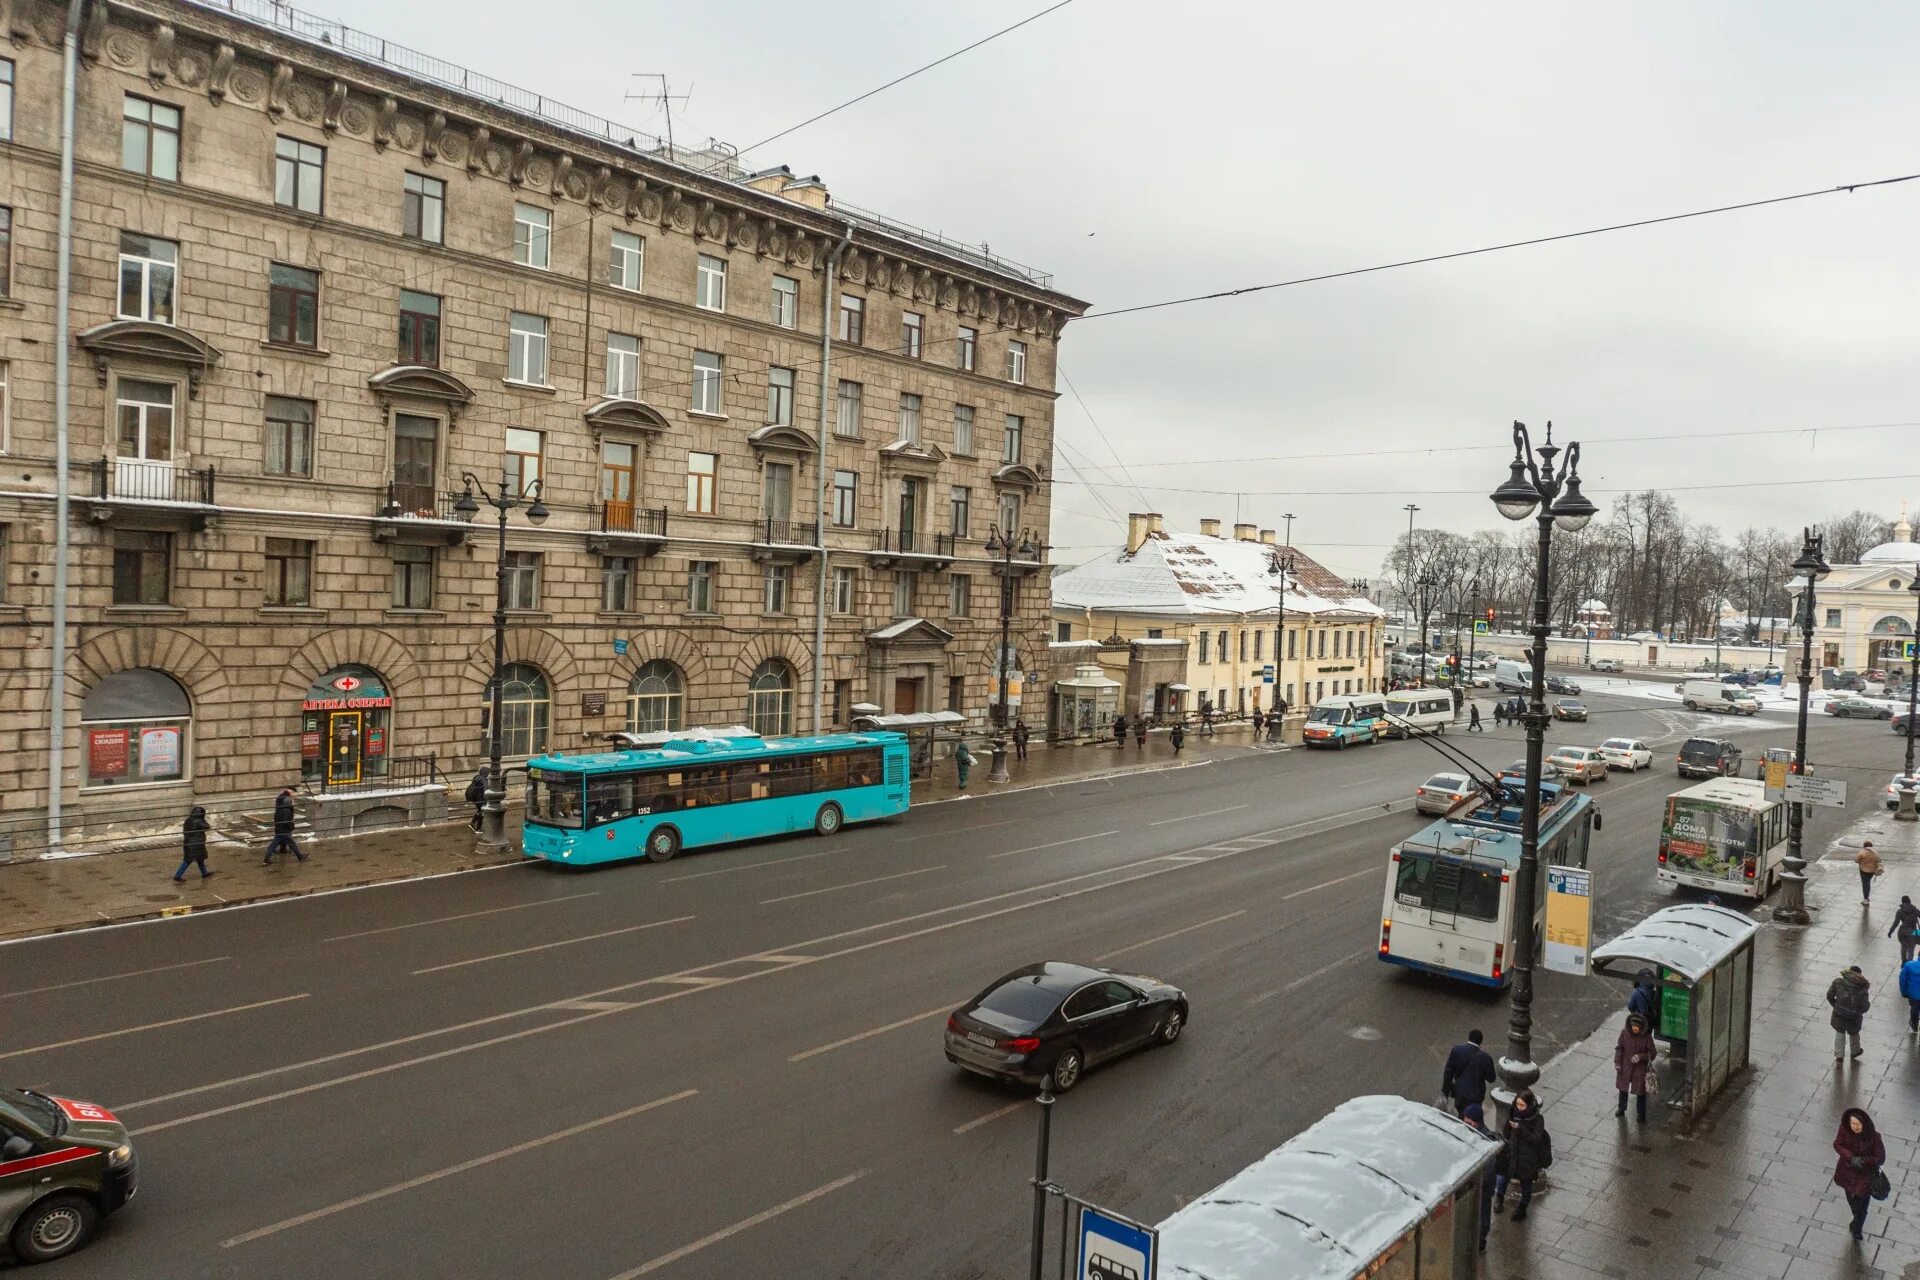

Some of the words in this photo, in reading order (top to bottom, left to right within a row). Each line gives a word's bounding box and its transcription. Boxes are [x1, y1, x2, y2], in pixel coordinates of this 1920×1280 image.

[303, 698, 347, 711] АПТЕКА
[348, 697, 393, 709] ОЗЕРКИ
[1673, 822, 1707, 835] ДОМА
